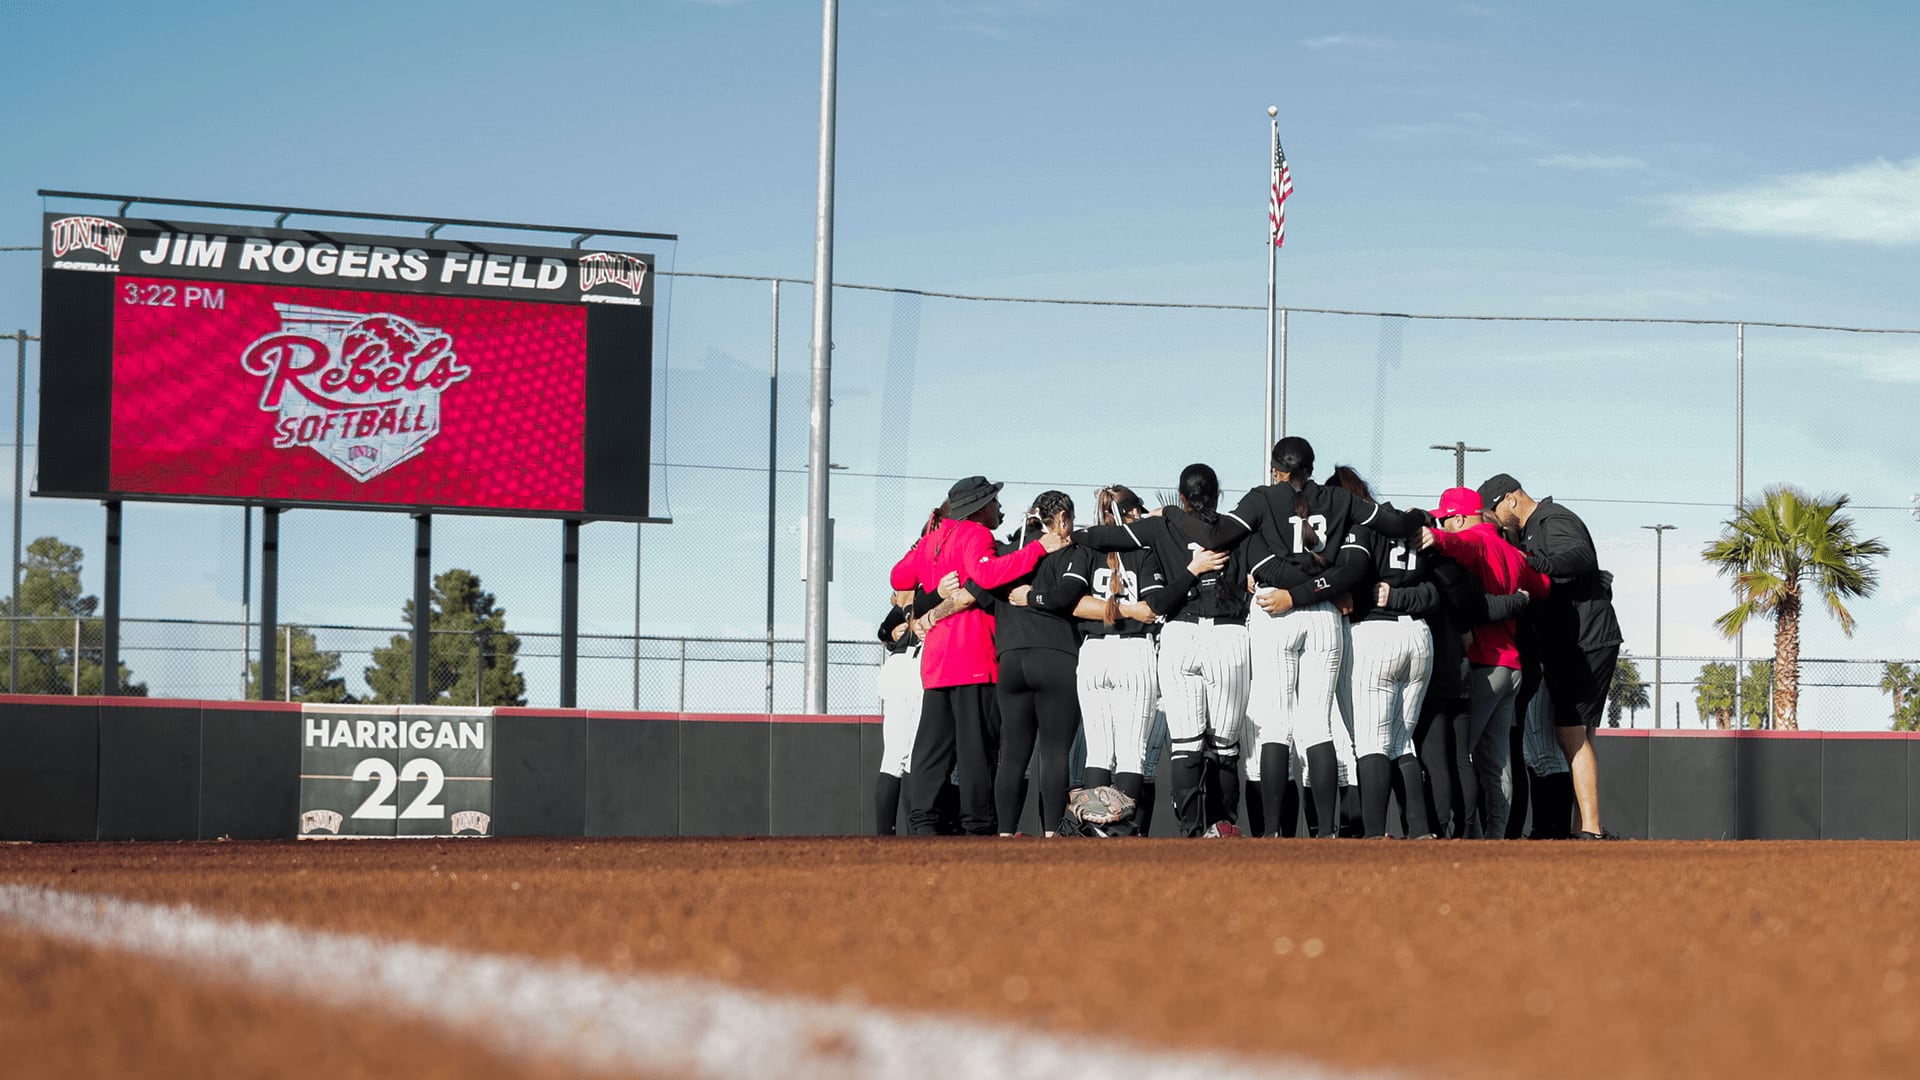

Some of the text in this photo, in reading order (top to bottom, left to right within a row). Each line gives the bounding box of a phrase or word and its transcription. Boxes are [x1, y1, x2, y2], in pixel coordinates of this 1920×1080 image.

[51, 216, 127, 261] UNLV
[140, 232, 568, 290] JIM ROGERS FIELD
[579, 252, 647, 295] UNLV
[123, 282, 226, 310] 3:22 PM
[241, 332, 471, 411] Rebels
[273, 405, 429, 447] SOFTBALL
[305, 718, 485, 750] HARRIGAN
[351, 757, 445, 819] 22
